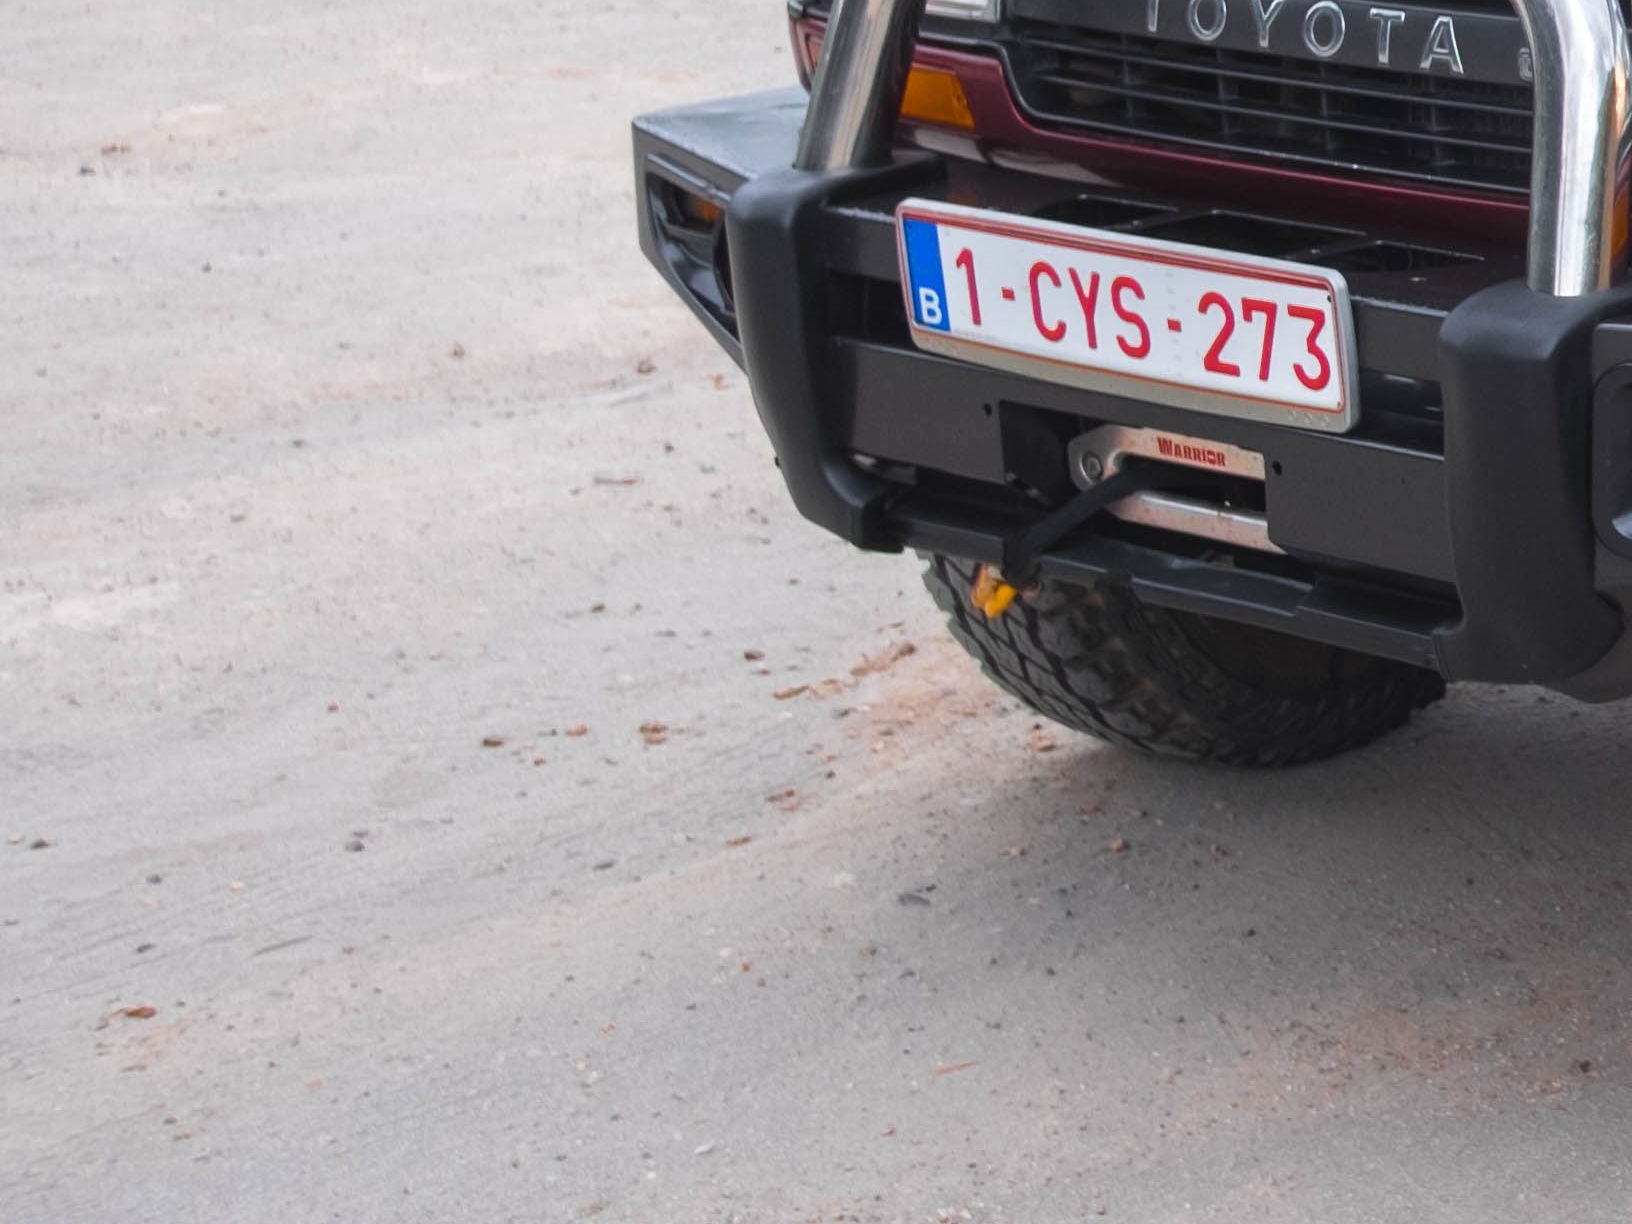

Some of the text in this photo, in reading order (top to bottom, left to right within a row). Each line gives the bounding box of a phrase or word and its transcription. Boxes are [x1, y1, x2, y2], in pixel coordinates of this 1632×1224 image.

[918, 287, 943, 325] B
[956, 247, 1331, 391] 1-CYS-273
[1157, 436, 1226, 467] WARRIOR
